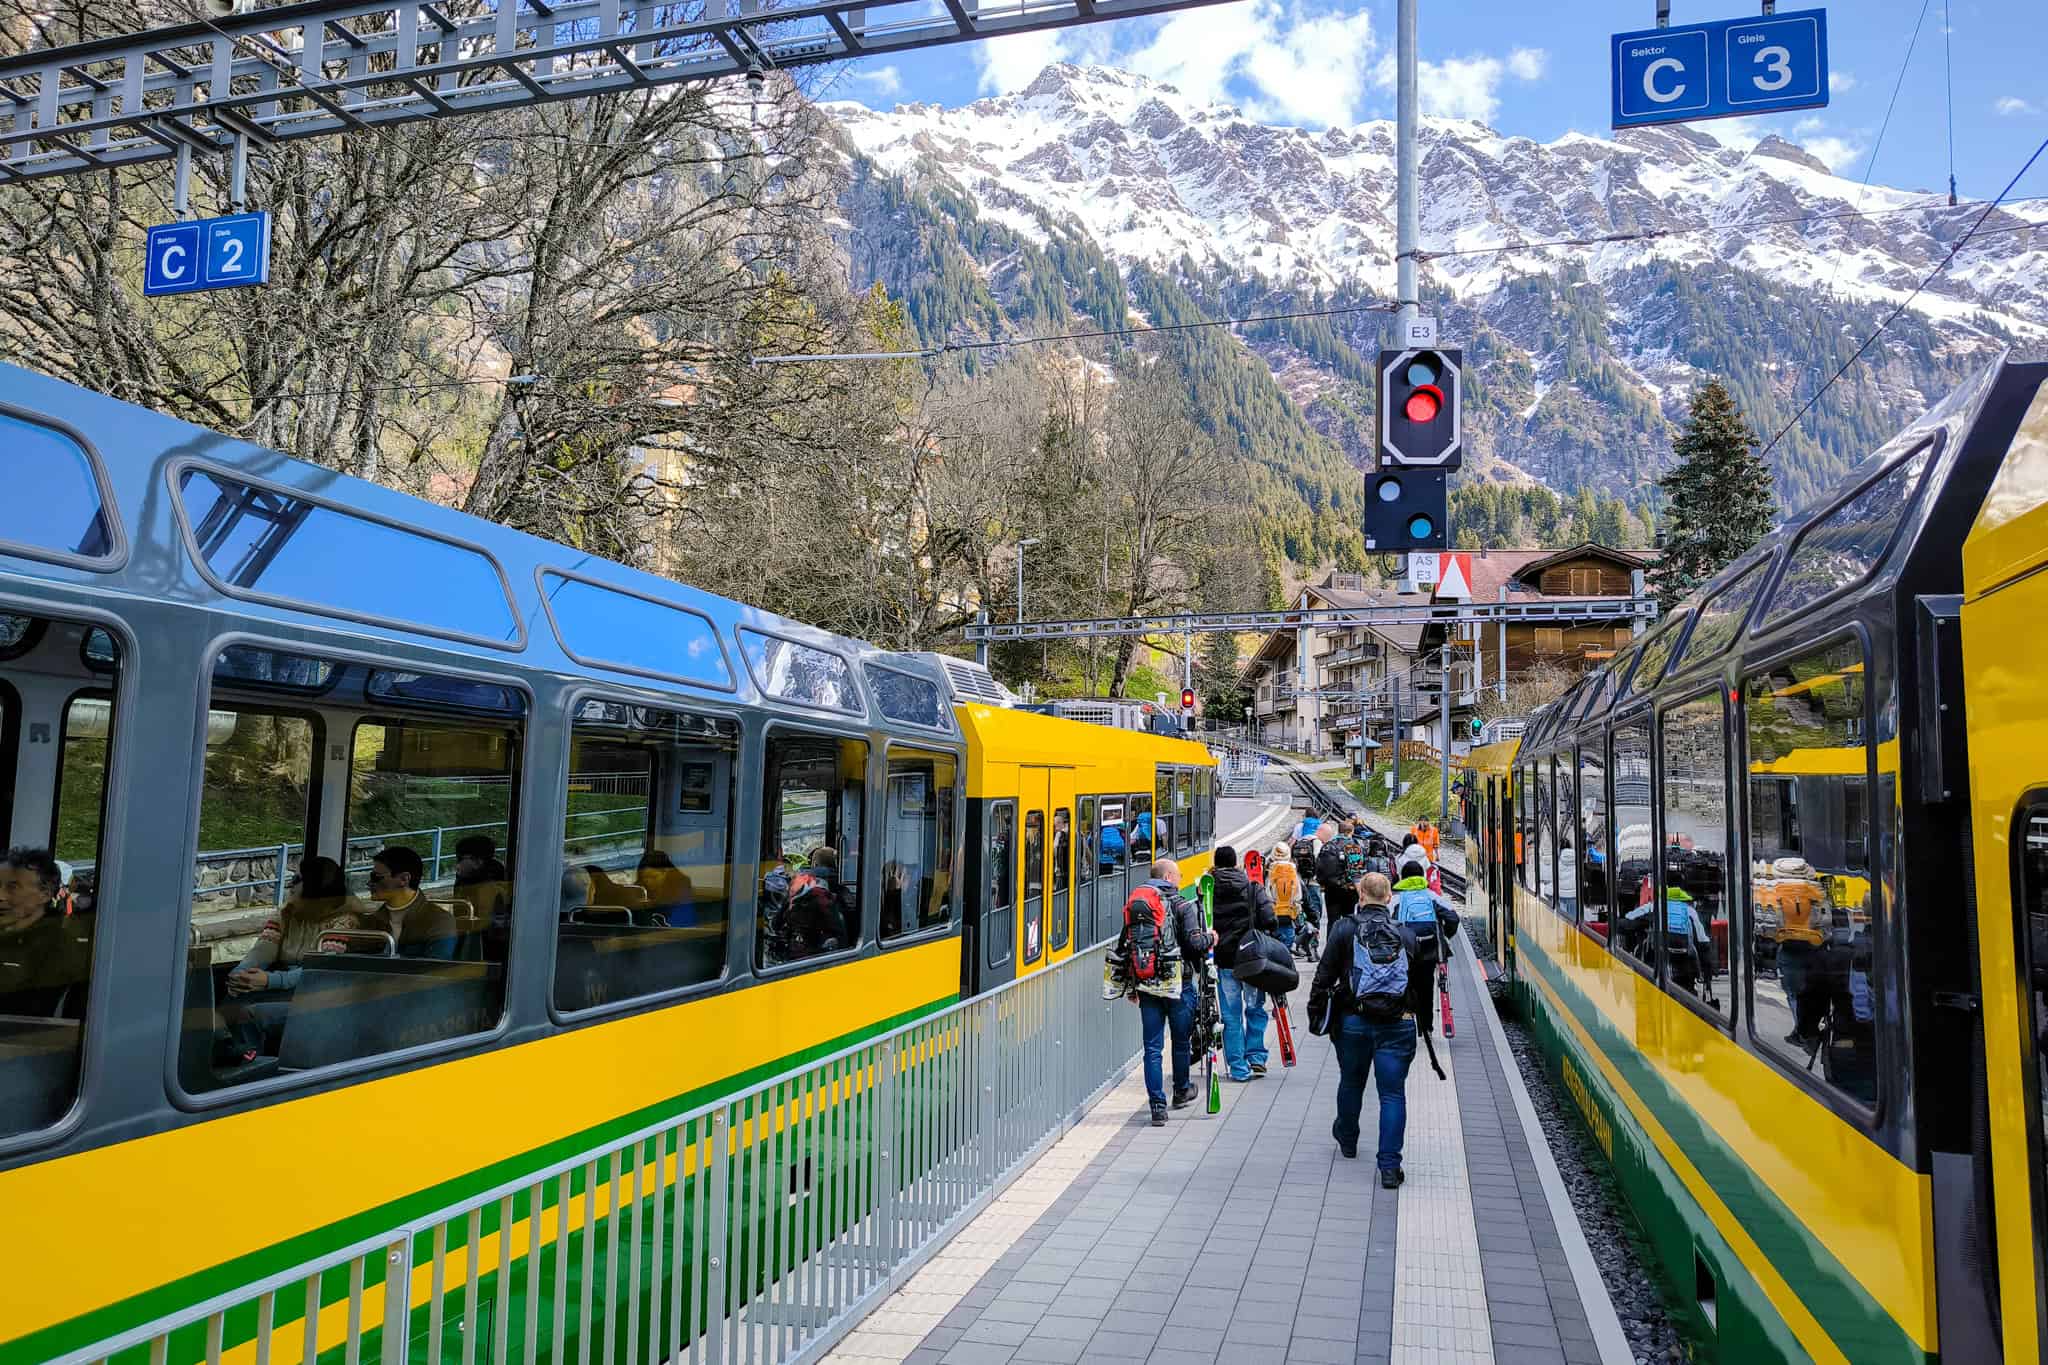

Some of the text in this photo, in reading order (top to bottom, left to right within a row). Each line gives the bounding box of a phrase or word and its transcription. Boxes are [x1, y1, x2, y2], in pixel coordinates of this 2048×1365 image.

[1737, 34, 1766, 45] Gleis
[1631, 46, 1667, 57] Sektor
[1752, 46, 1793, 91] 3
[1643, 57, 1687, 103] C
[221, 238, 244, 273] 2
[161, 245, 187, 280] C
[1411, 326, 1430, 338] E3
[1415, 555, 1433, 566] AS
[1416, 569, 1432, 581] E3
